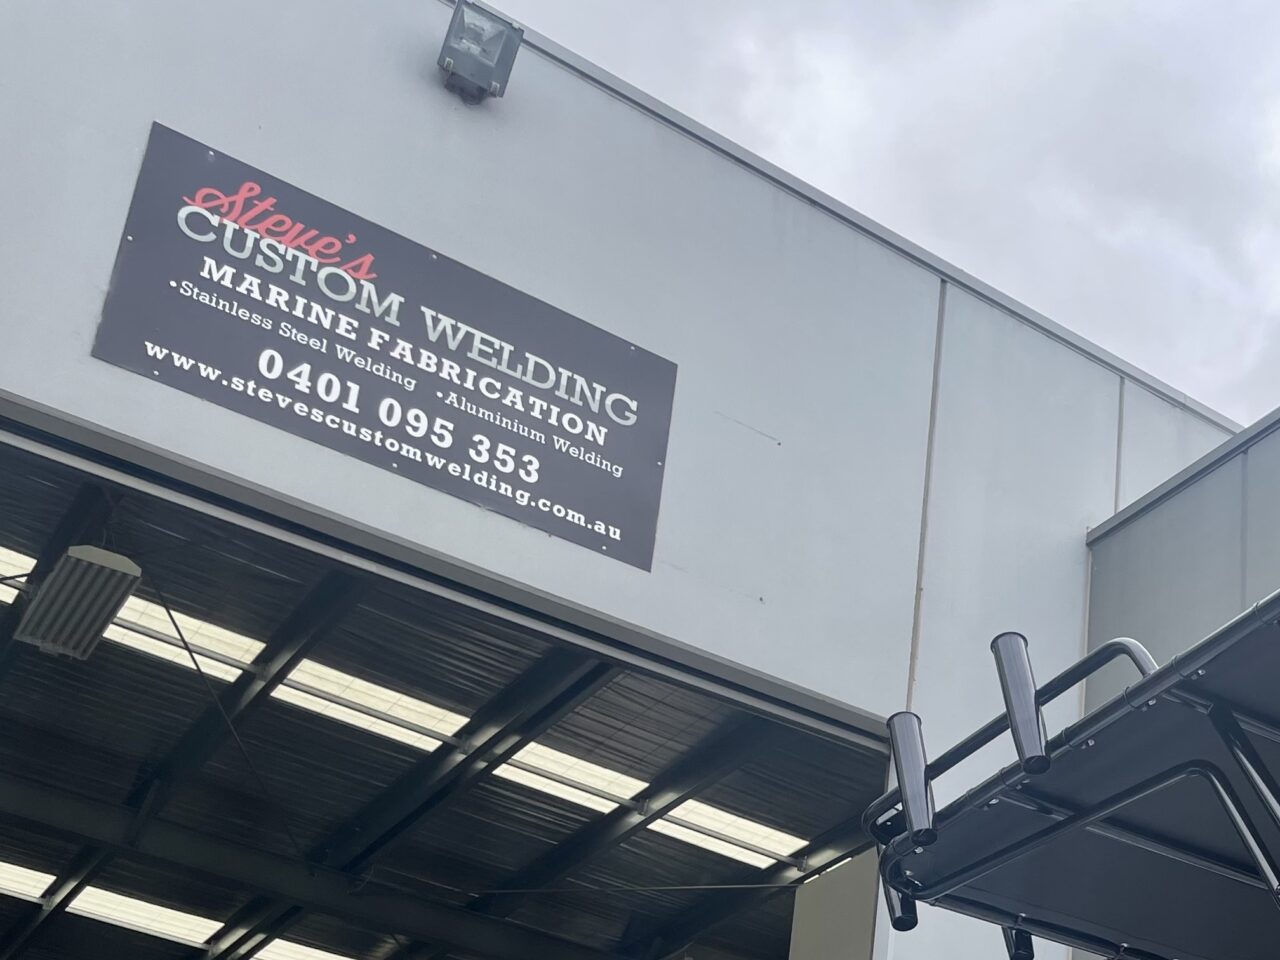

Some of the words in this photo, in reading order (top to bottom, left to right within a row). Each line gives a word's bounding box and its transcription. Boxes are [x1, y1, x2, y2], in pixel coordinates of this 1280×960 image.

[182, 181, 377, 280] Steve's
[177, 205, 404, 326] CUSTOM
[420, 306, 638, 426] WELDING
[200, 256, 358, 340] MARINE
[367, 328, 608, 446] FABRICATION
[278, 322, 328, 353] Steel
[335, 344, 417, 391] Welding
[144, 341, 621, 540] www.stevescustomwelding.com.au
[258, 349, 361, 414] 0401
[378, 397, 454, 448] 095
[468, 434, 540, 483] 353
[552, 435, 624, 478] Welding
